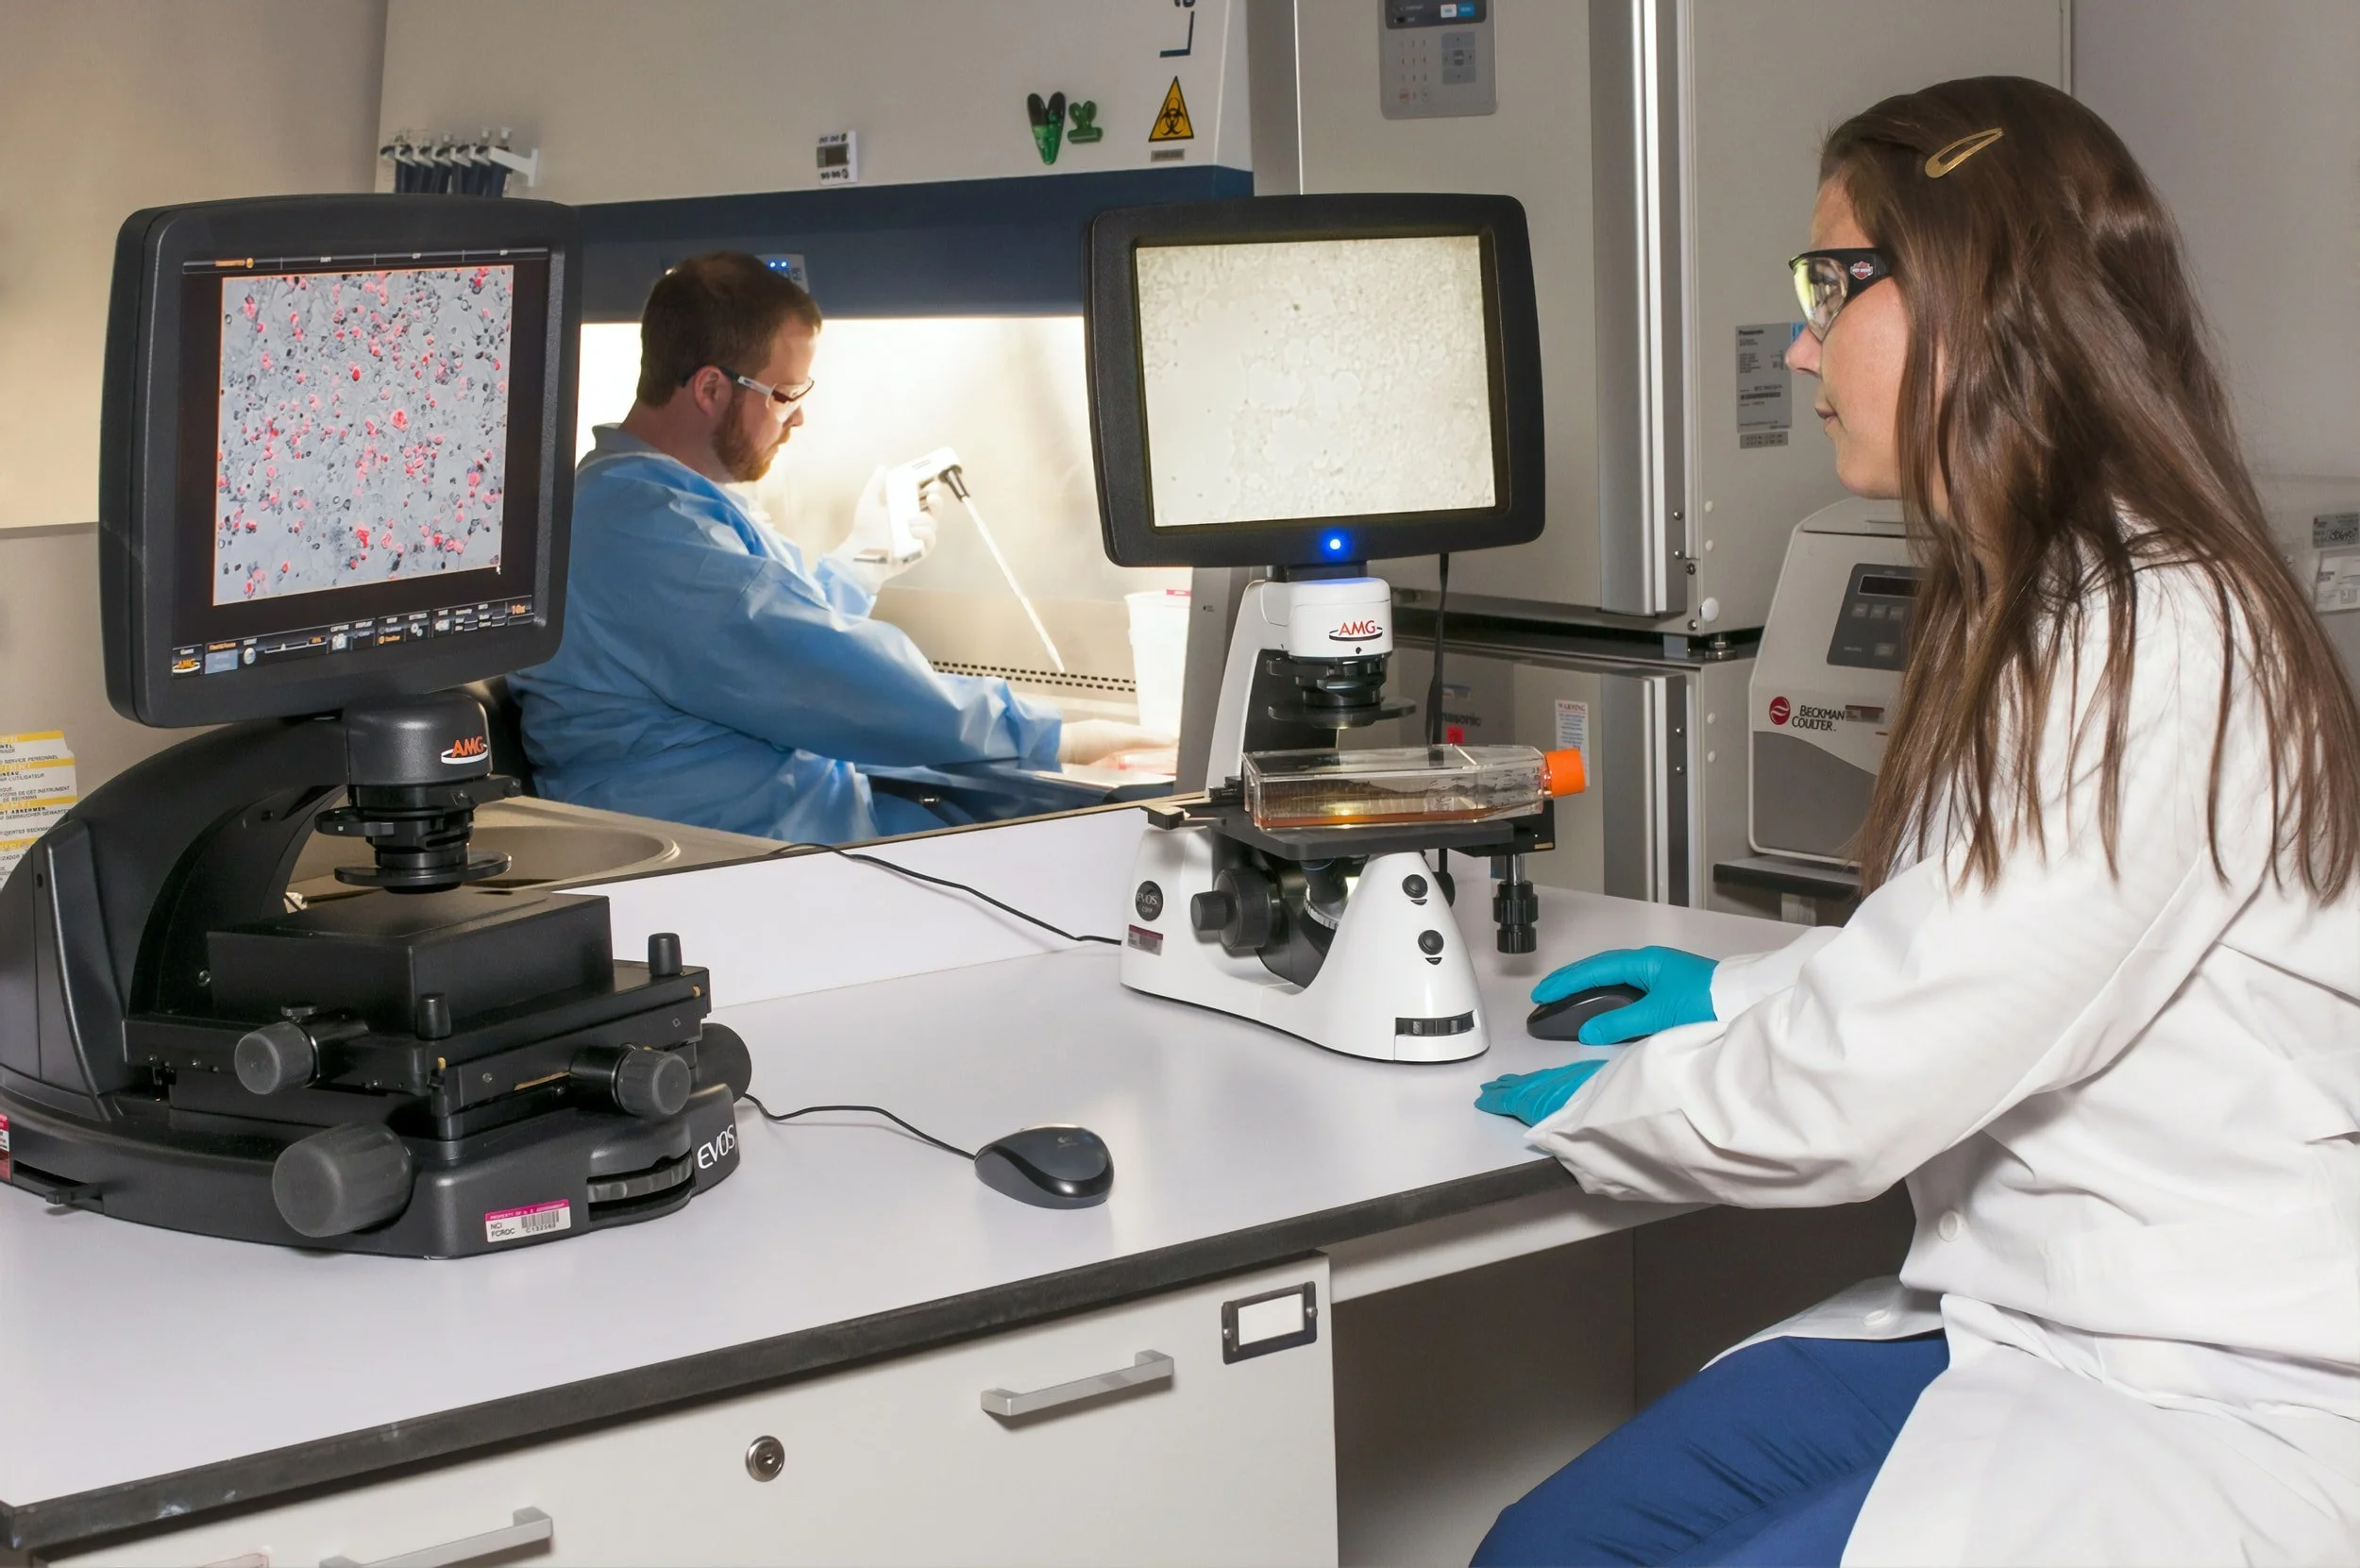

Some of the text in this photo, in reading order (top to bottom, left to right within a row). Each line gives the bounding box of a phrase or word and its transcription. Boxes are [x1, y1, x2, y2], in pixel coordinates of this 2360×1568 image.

[1339, 619, 1376, 636] AMG
[1558, 702, 1587, 712] WARNING
[1799, 704, 1846, 721] BECKMAN
[451, 735, 484, 758] AMG
[697, 1123, 735, 1170] EVOS
